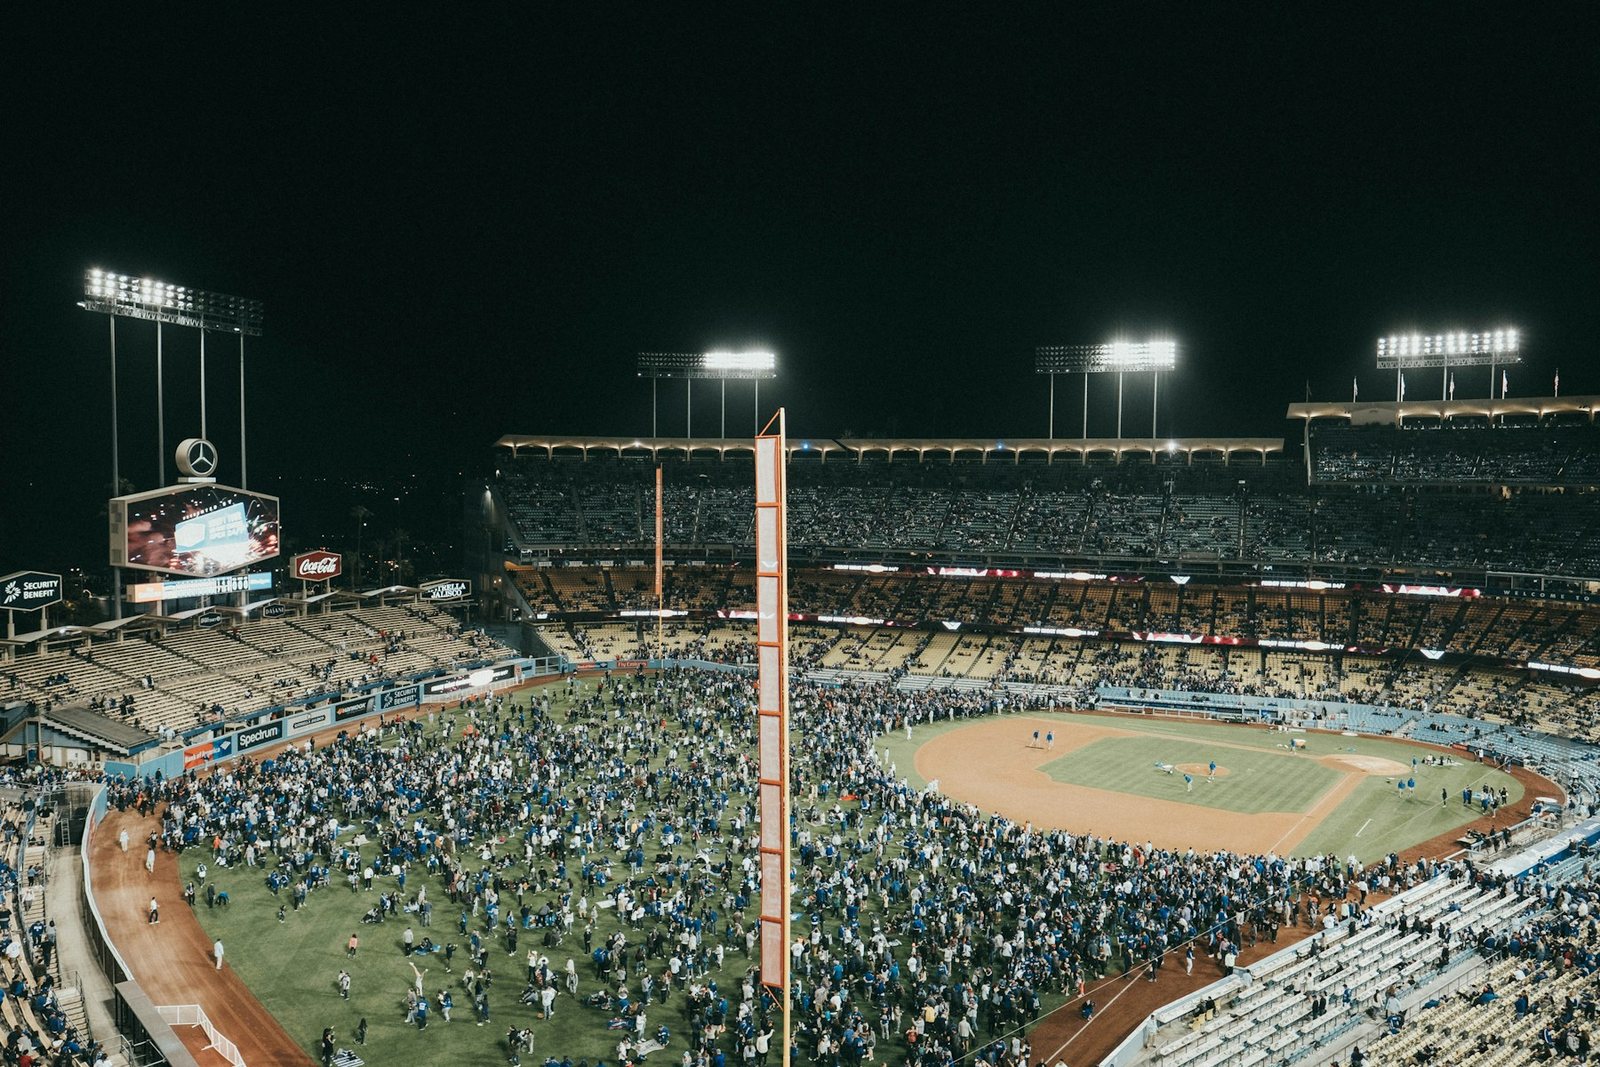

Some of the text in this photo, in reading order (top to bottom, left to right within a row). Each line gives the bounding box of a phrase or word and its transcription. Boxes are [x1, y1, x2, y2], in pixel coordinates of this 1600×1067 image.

[299, 557, 339, 575] Coca-Cola
[23, 580, 58, 591] SECURITY
[23, 589, 54, 600] BENEFIT
[431, 590, 462, 599] JALISCO
[1503, 590, 1565, 599] WELCOME
[394, 687, 418, 698] SECURITY
[394, 694, 415, 705] BENEFIT
[239, 726, 278, 747] Spectrum
